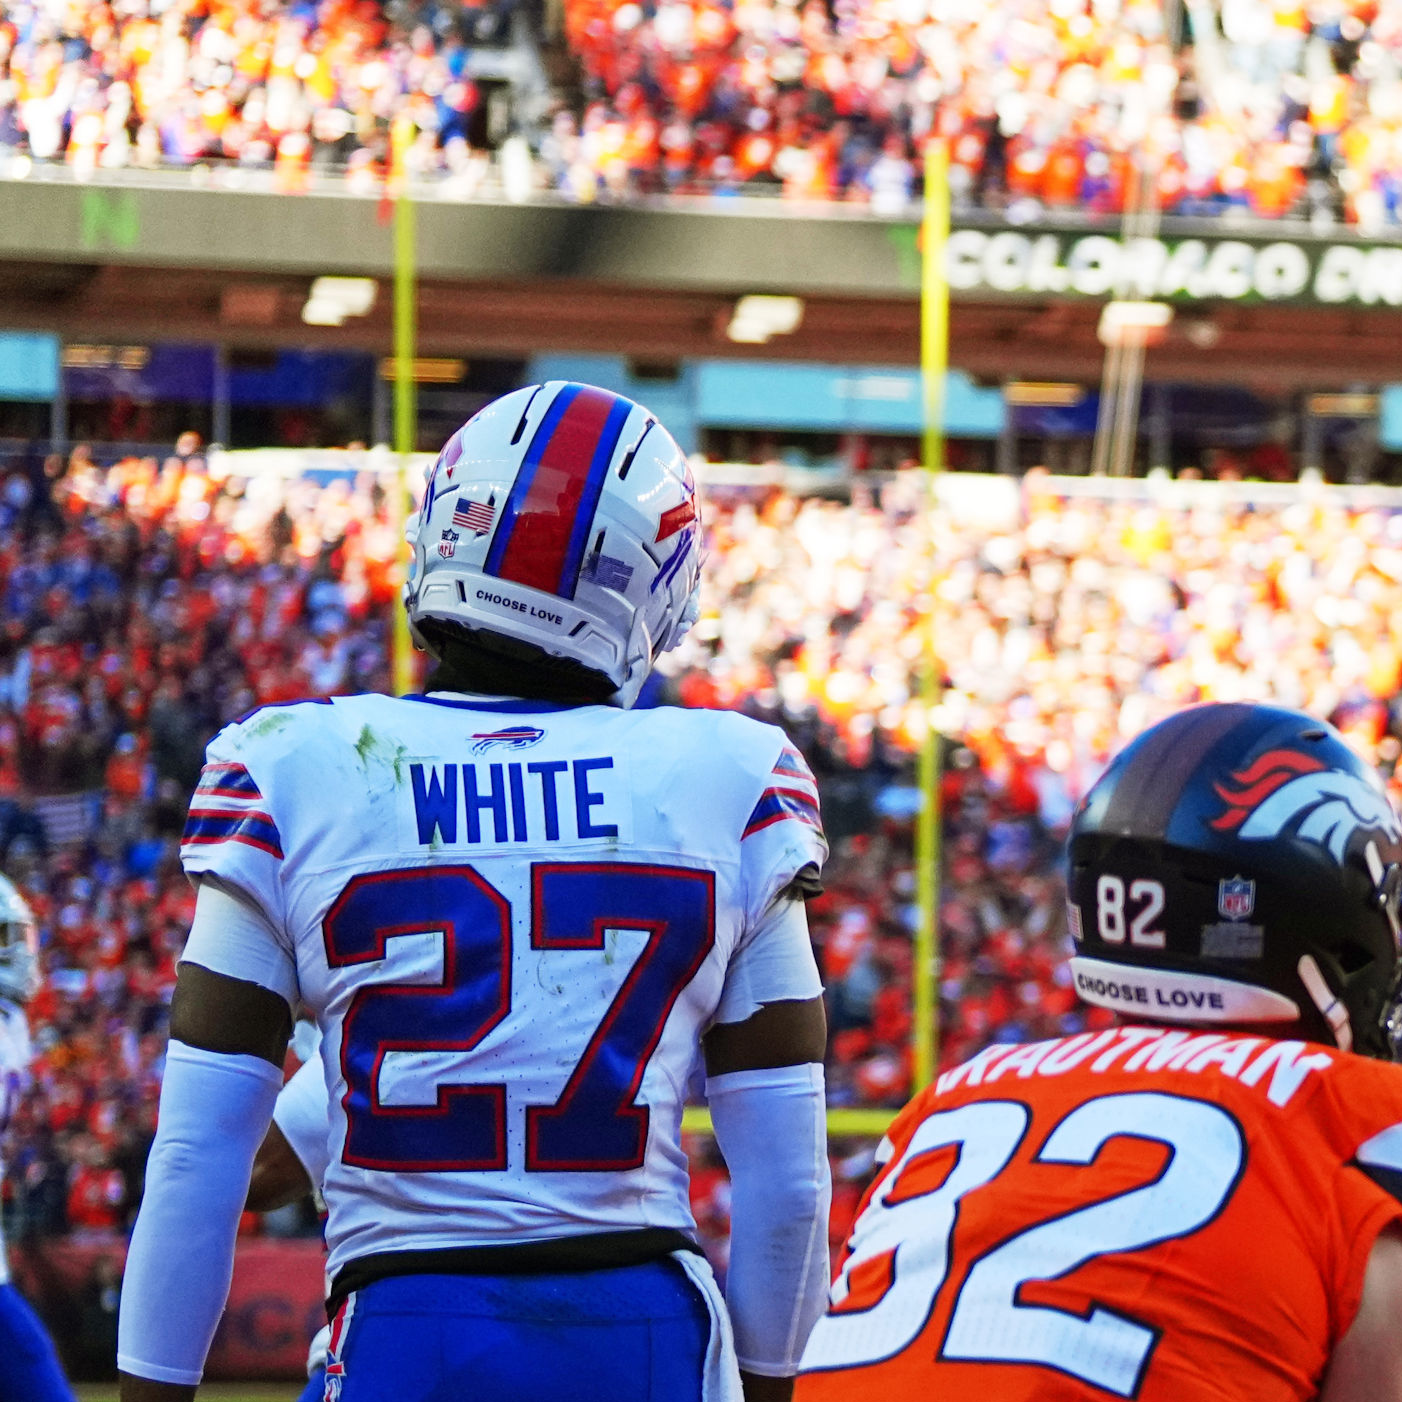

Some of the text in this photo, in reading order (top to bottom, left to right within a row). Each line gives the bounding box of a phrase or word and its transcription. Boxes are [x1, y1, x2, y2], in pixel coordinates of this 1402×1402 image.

[476, 590, 563, 625] CHOOSE LOVE
[410, 756, 619, 845] WHITE
[1097, 874, 1166, 948] 82
[322, 860, 716, 1172] 27
[1078, 973, 1224, 1009] CHOOSE LOVE
[800, 1091, 1249, 1401] 82
